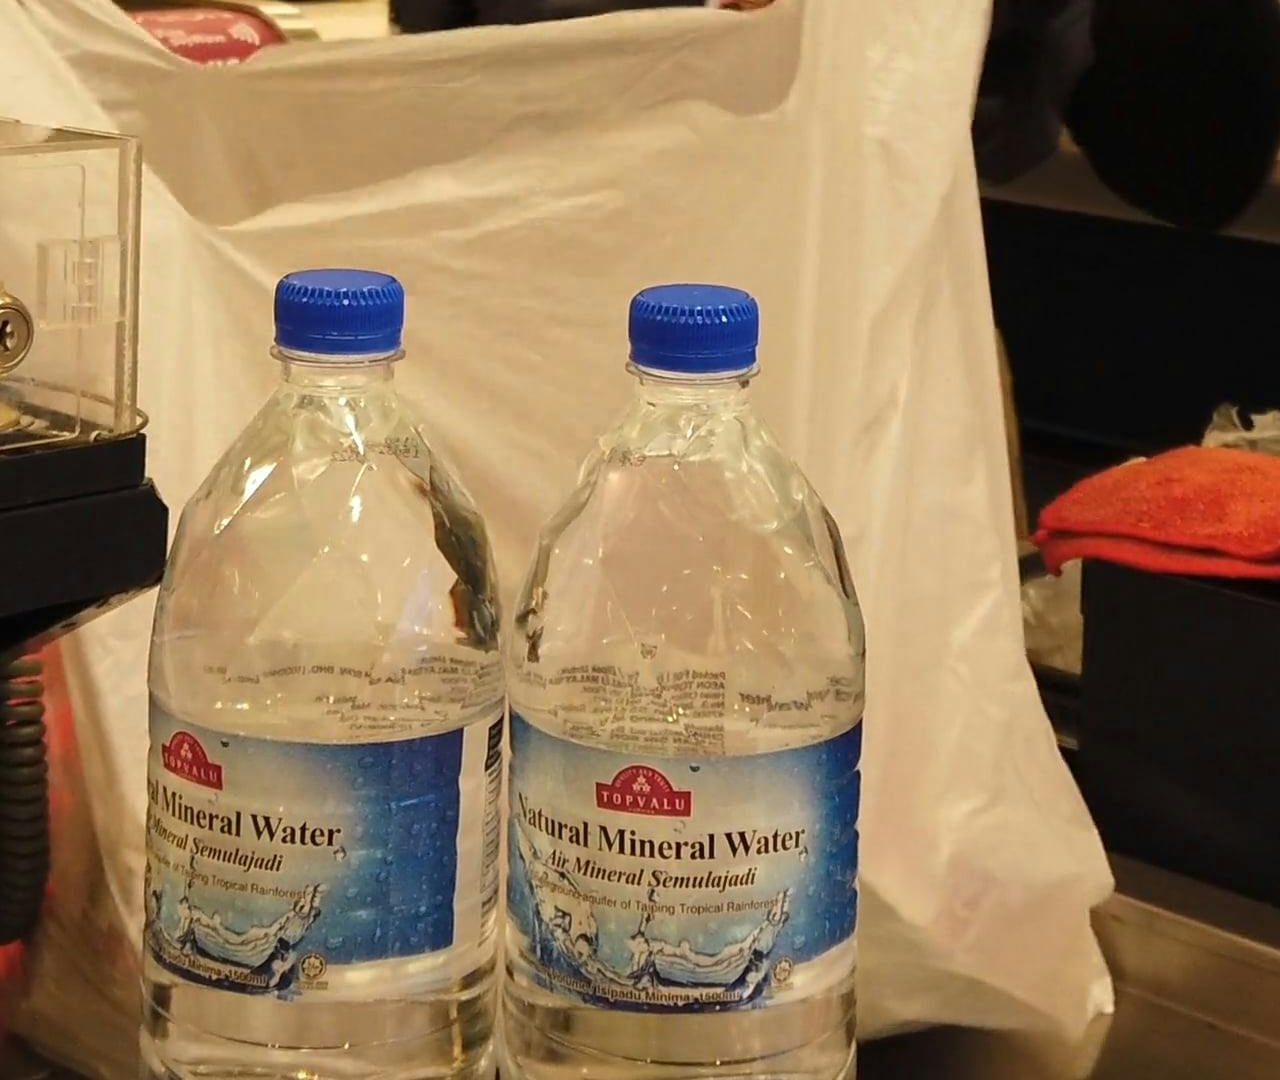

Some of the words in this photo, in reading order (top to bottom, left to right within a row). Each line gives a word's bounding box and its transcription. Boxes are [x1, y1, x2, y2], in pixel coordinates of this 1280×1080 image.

[163, 751, 218, 783] TOPVALU
[162, 785, 241, 838] Mineral
[250, 813, 342, 847] Water
[601, 790, 685, 810] TOPVALU
[151, 816, 188, 850] Mineral
[191, 836, 285, 873] Semulajadi
[518, 791, 590, 848] Natural
[597, 823, 715, 861] Mineral
[723, 827, 805, 858] Water
[211, 873, 249, 894] Tropical
[545, 848, 570, 870] Air
[572, 855, 644, 887] Mineral
[647, 866, 758, 895] Semulajadi
[620, 899, 632, 910] of
[679, 901, 724, 916] Tropical
